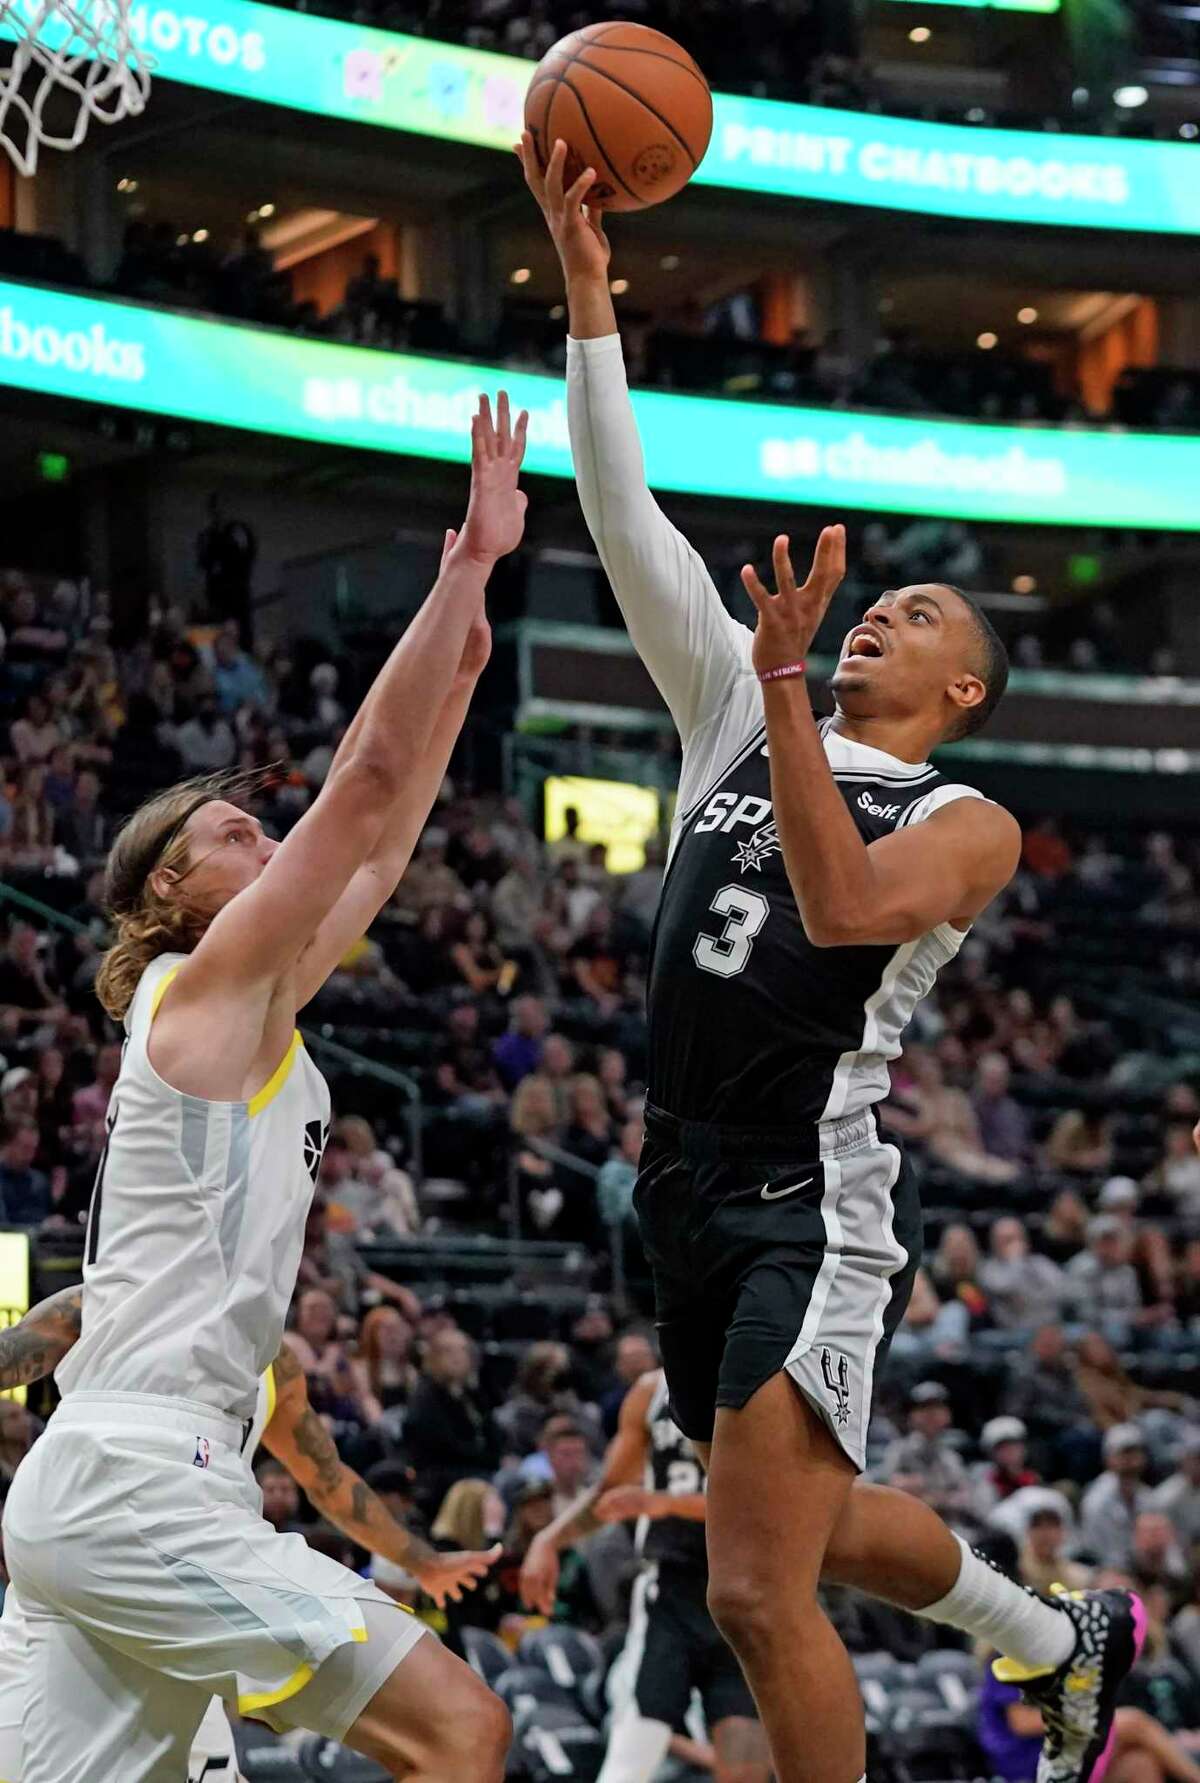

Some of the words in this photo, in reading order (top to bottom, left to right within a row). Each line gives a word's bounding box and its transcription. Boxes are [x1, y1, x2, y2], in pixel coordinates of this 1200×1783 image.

[724, 124, 851, 173] PRINT
[860, 142, 1128, 203] CHATBOOKS
[0, 304, 145, 382] books
[693, 884, 769, 977] 3
